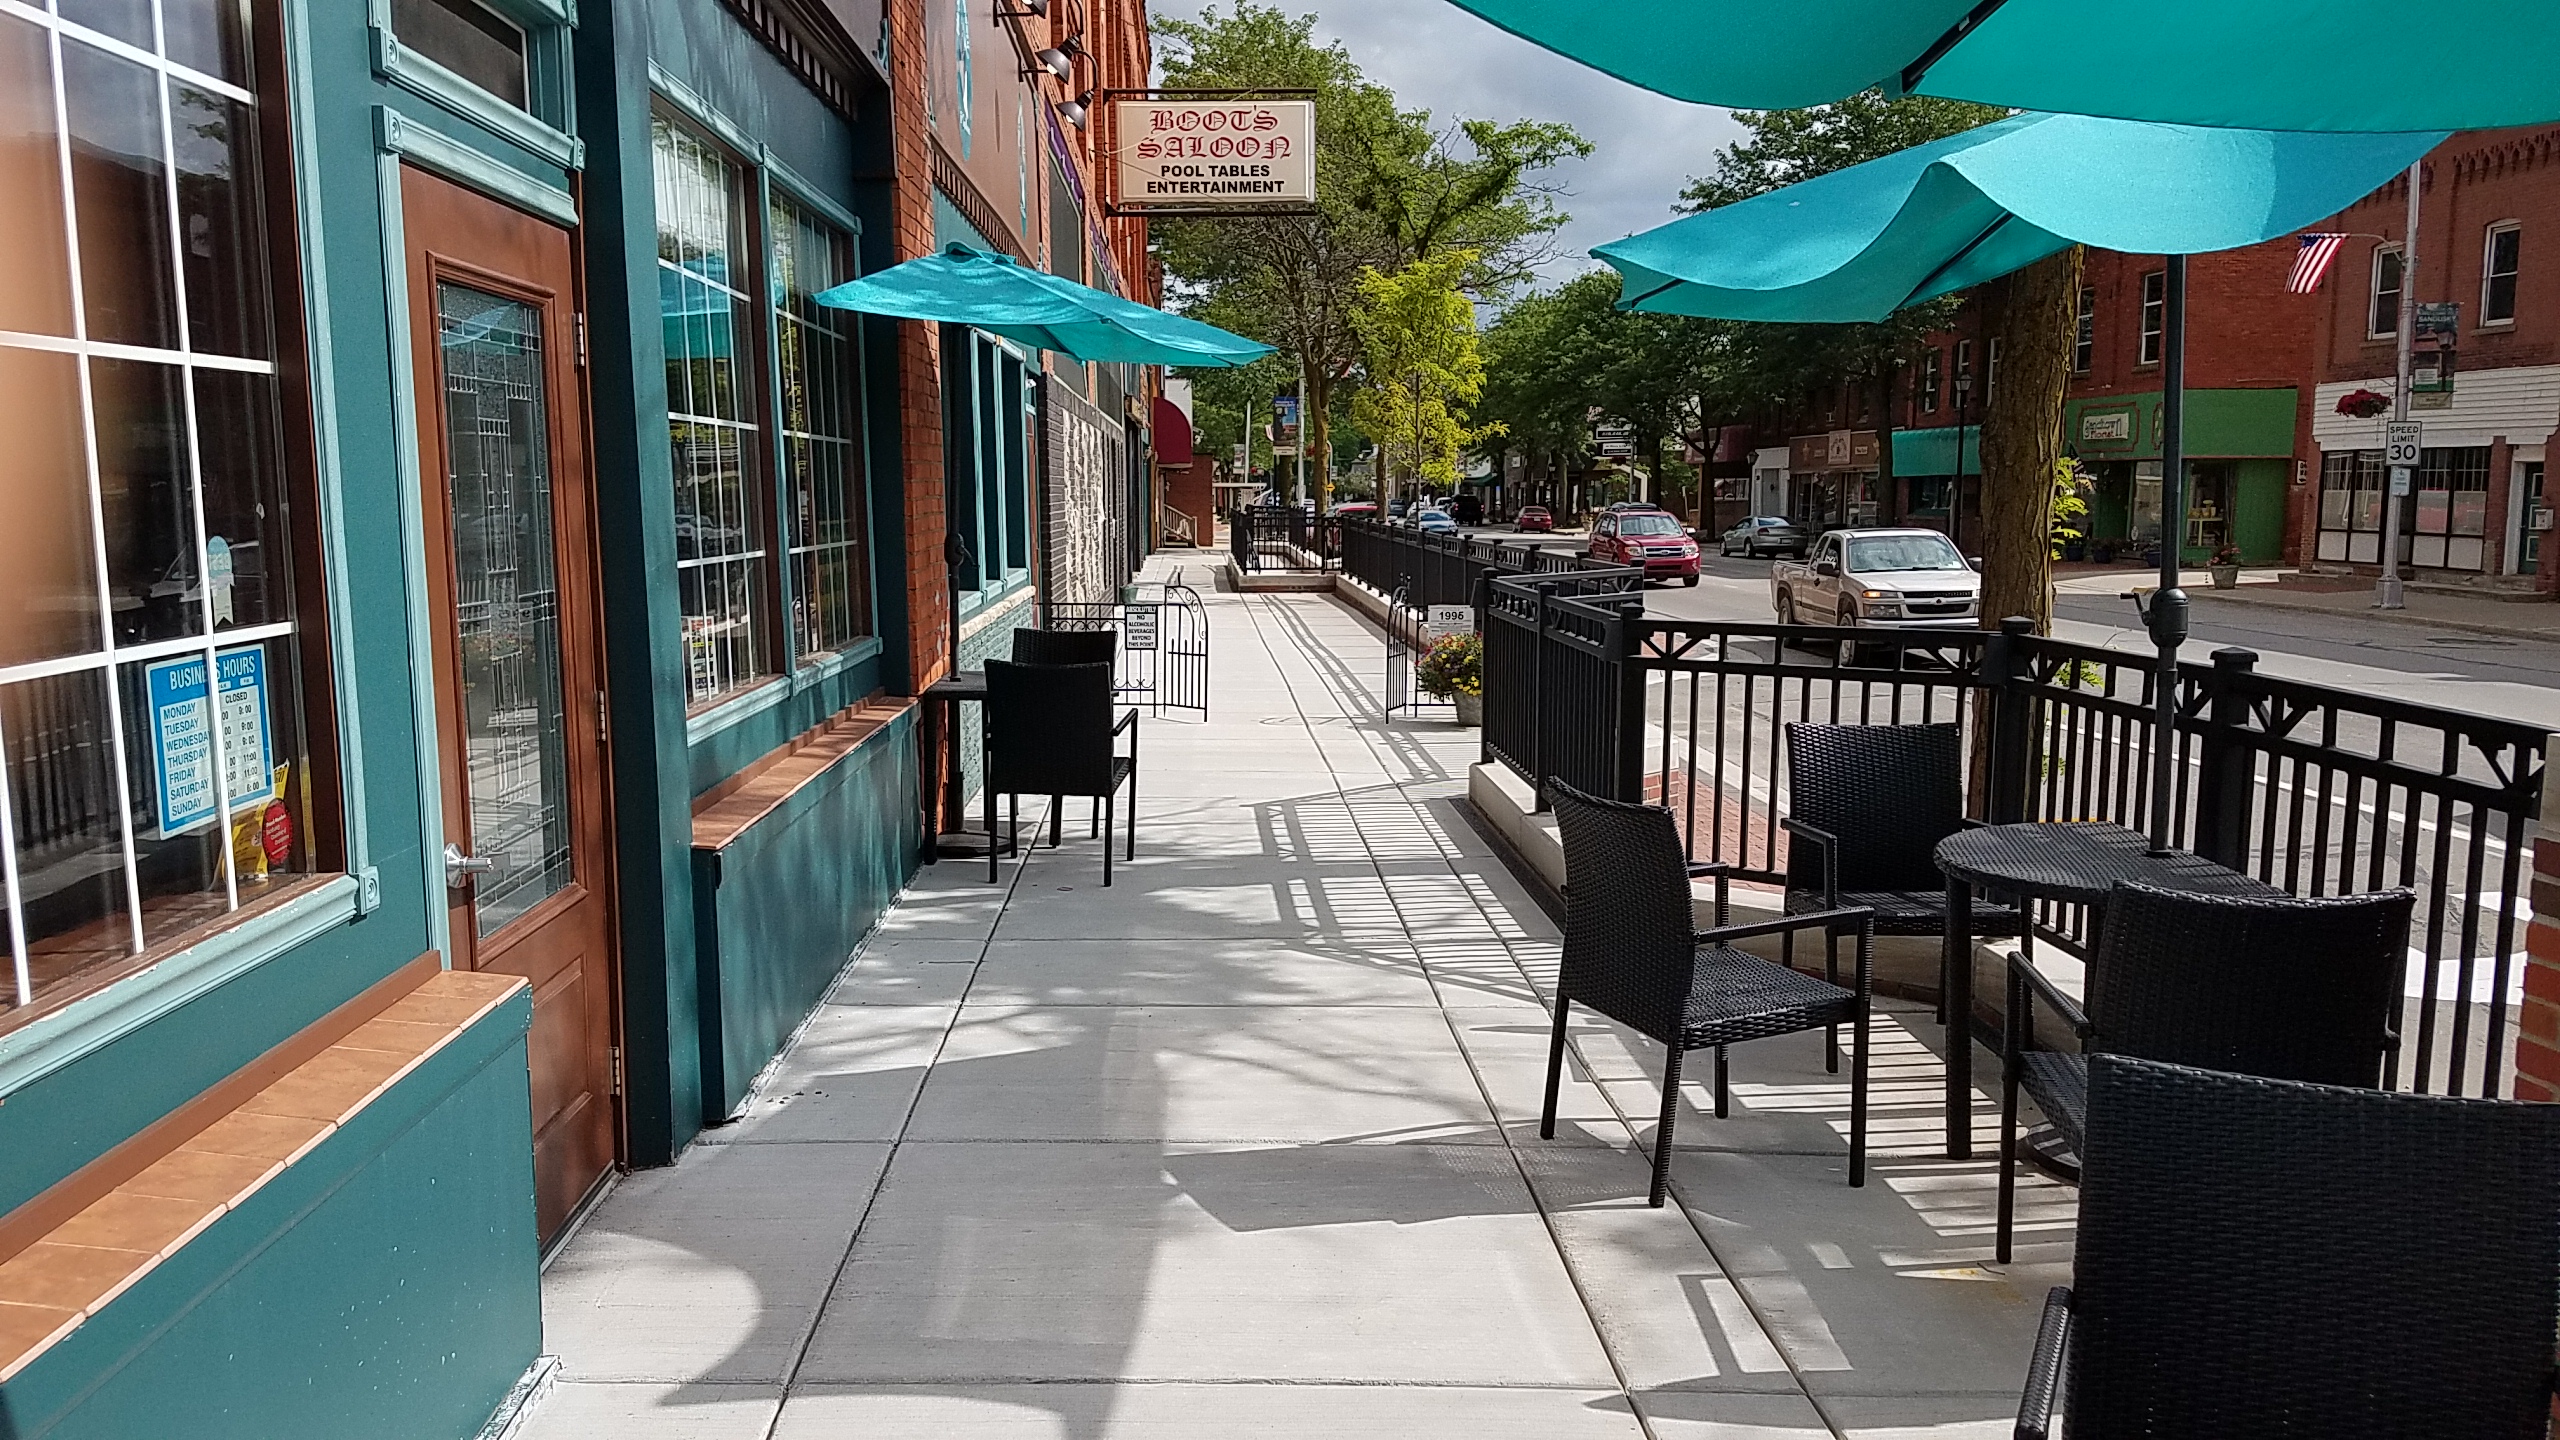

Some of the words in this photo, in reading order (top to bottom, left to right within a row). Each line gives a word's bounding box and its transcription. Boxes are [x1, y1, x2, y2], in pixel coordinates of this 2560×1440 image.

[1137, 136, 1292, 160] SALOON
[1161, 165, 1205, 177] POOL
[1208, 165, 1270, 177] TABLES
[1147, 181, 1285, 194] ENTERTAINMENT
[2389, 426, 2419, 434] SPEED
[2391, 435, 2415, 443] LIMIT
[2389, 444, 2416, 461] 30
[222, 655, 256, 679] HOURS
[225, 691, 248, 704] CLOSED
[163, 701, 196, 721] MONDAY
[164, 717, 199, 737] TUESDAY
[166, 730, 212, 752] WEDNESDAY
[167, 746, 208, 769] THURSDAY
[169, 766, 196, 785] FRIDAY
[170, 778, 210, 801] SATURDAY
[171, 796, 202, 817] SUNDAY
